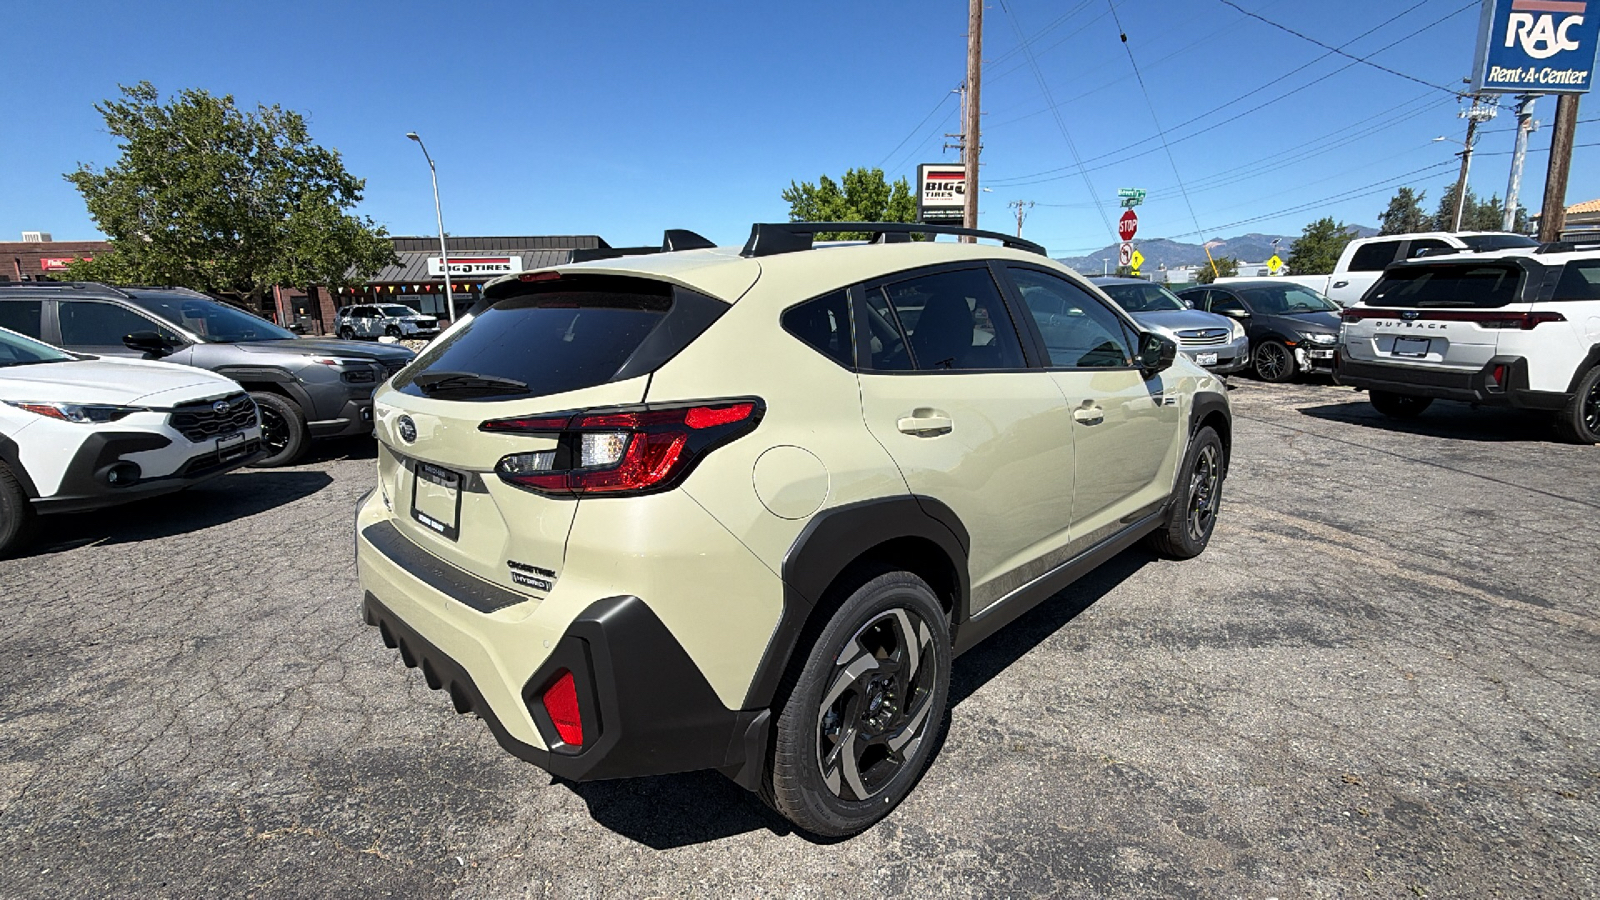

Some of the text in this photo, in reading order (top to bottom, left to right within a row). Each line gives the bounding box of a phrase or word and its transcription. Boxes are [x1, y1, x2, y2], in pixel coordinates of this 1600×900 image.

[1504, 12, 1584, 59] RAC
[925, 182, 955, 190] BIG
[1119, 219, 1137, 232] STOP
[1376, 321, 1448, 330] OUTBACK
[516, 576, 545, 588] HYBRID
